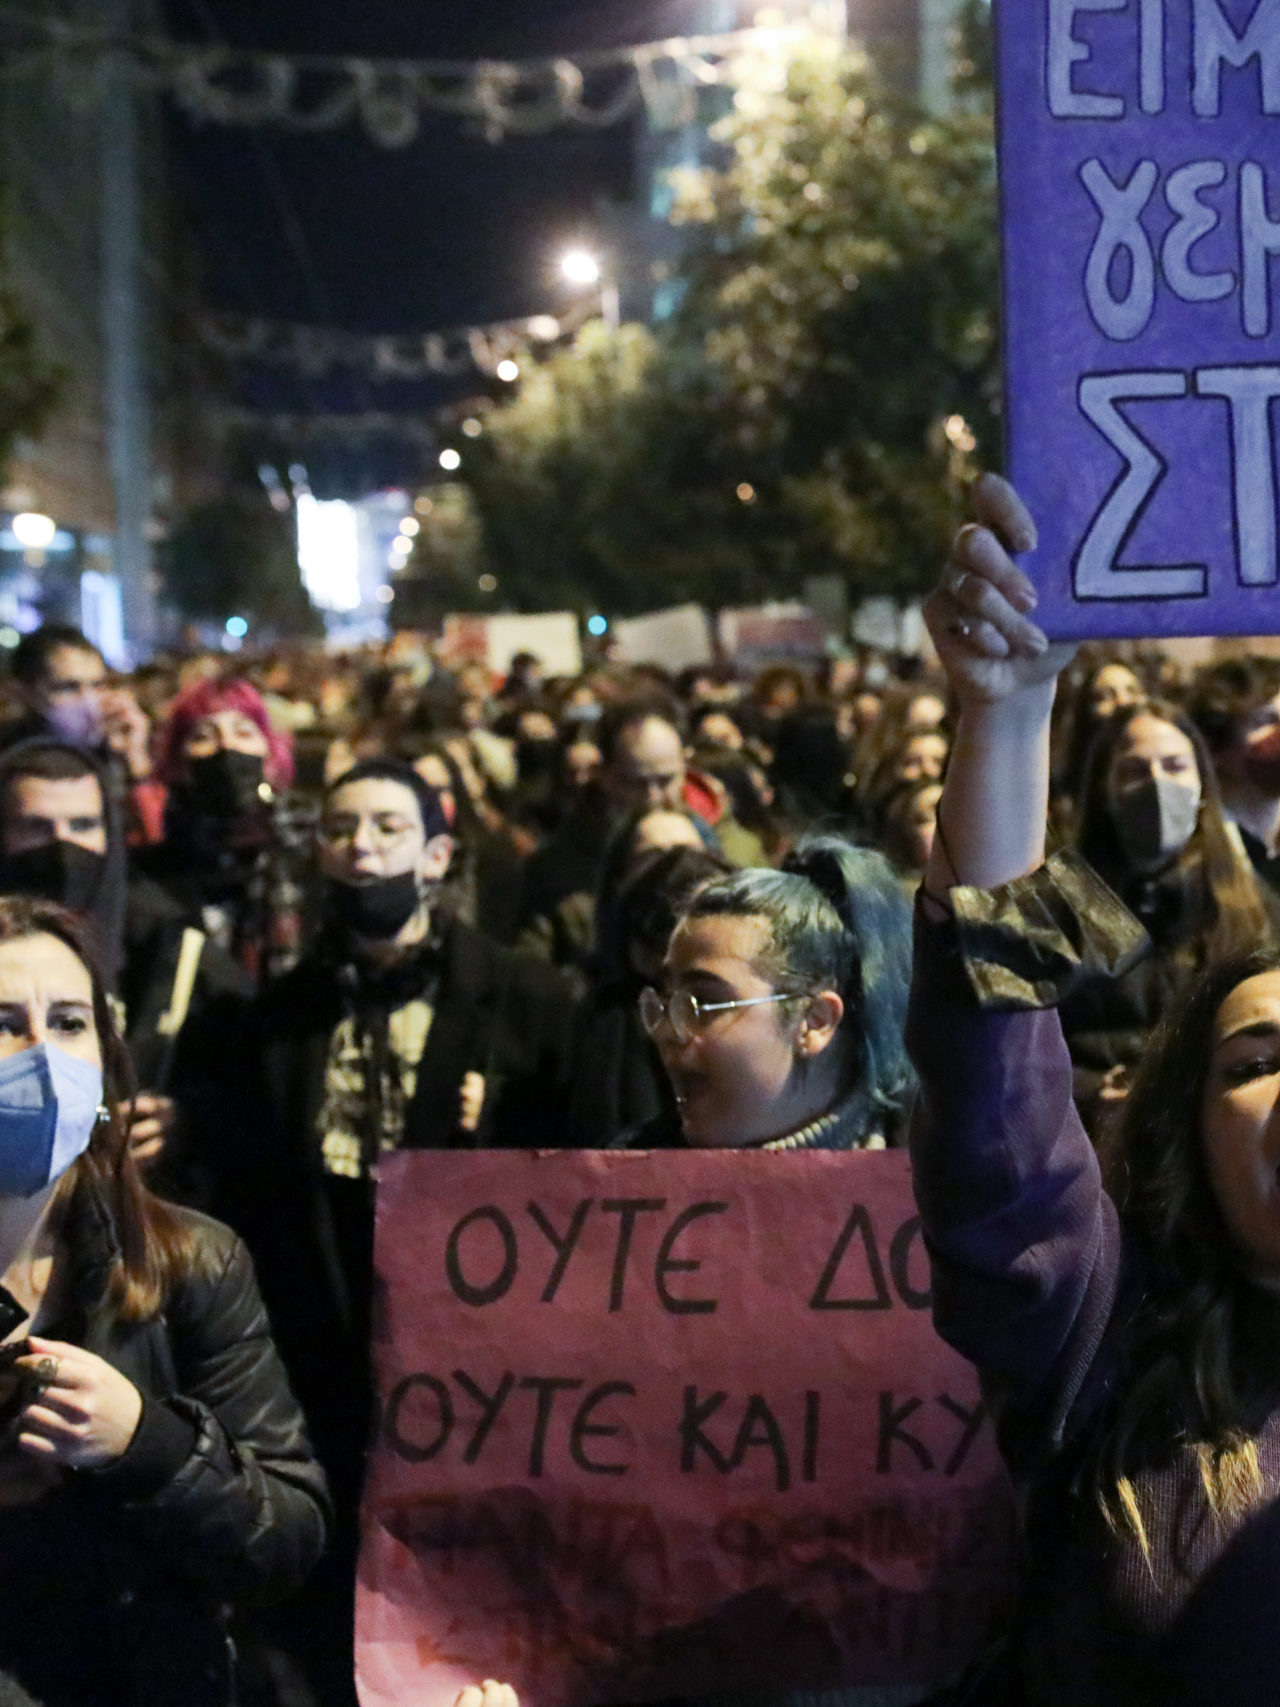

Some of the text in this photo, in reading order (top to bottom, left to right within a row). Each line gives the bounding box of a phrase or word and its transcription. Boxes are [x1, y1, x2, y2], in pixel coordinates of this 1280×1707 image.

[445, 1199, 729, 1315] ΟΥΤΕ
[386, 1370, 637, 1477] ΟΥΤΕ
[680, 1385, 820, 1491] ΚΑΙ
